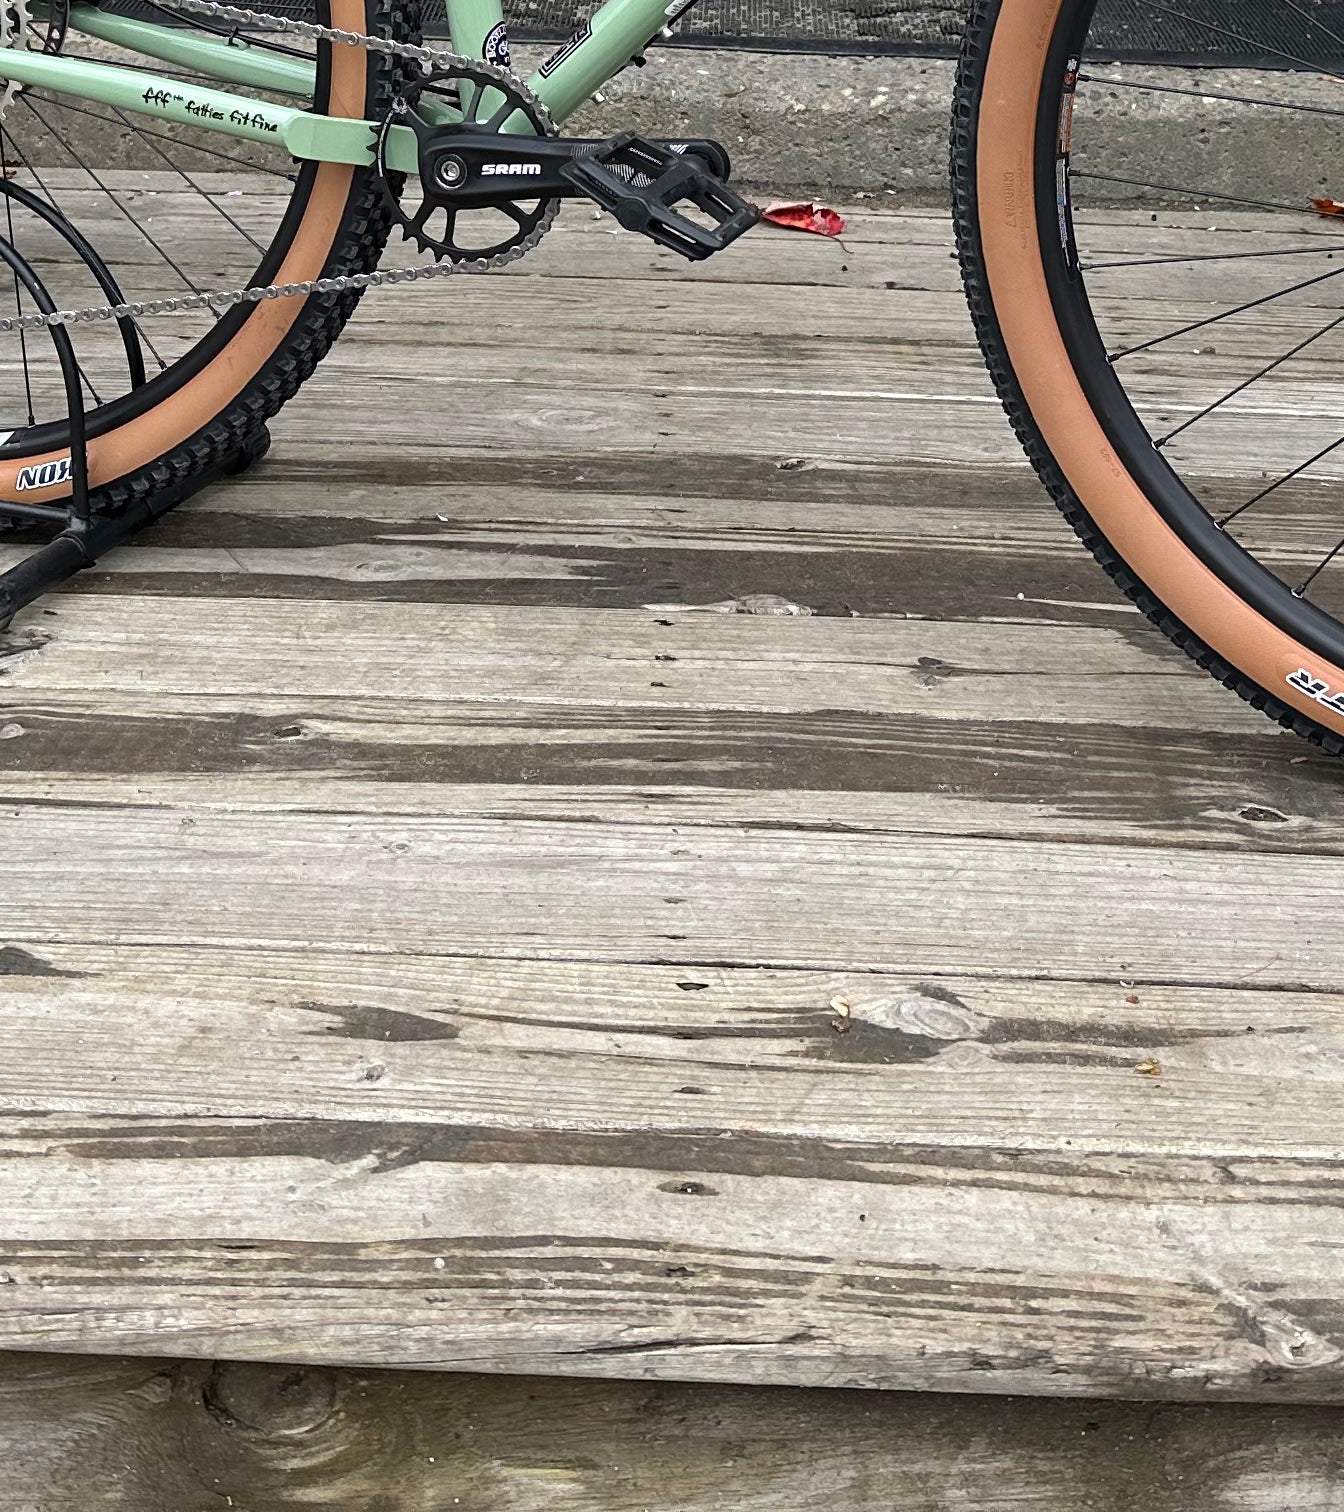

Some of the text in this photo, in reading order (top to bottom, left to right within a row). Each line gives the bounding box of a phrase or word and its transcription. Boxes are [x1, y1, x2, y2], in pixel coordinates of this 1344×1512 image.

[184, 99, 225, 121] fatties
[229, 109, 250, 125] fit
[250, 113, 278, 132] fine
[481, 163, 542, 176] SRAM
